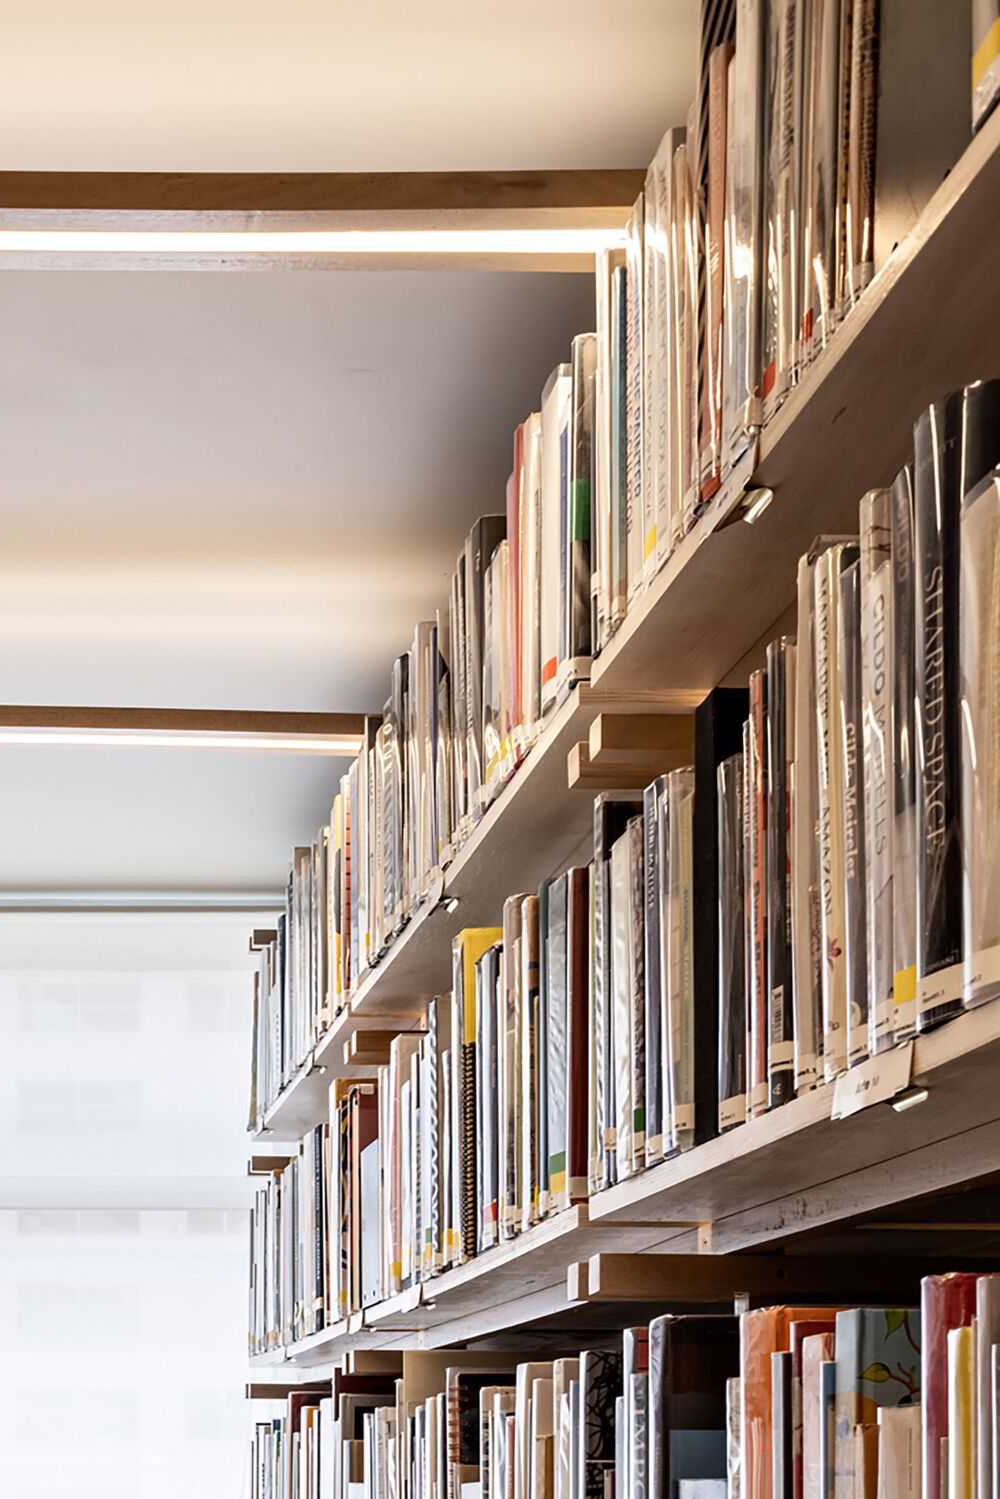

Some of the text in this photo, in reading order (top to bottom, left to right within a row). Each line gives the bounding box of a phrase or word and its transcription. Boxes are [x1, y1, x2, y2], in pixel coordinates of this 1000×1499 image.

[634, 406, 642, 498] PAINTER
[872, 593, 886, 697] CILDO
[925, 565, 946, 855] SHARED SPACE
[845, 721, 858, 880] Cildo Meireles
[647, 806, 656, 908] HENRI MATISSE
[822, 806, 833, 917] AMAZON
